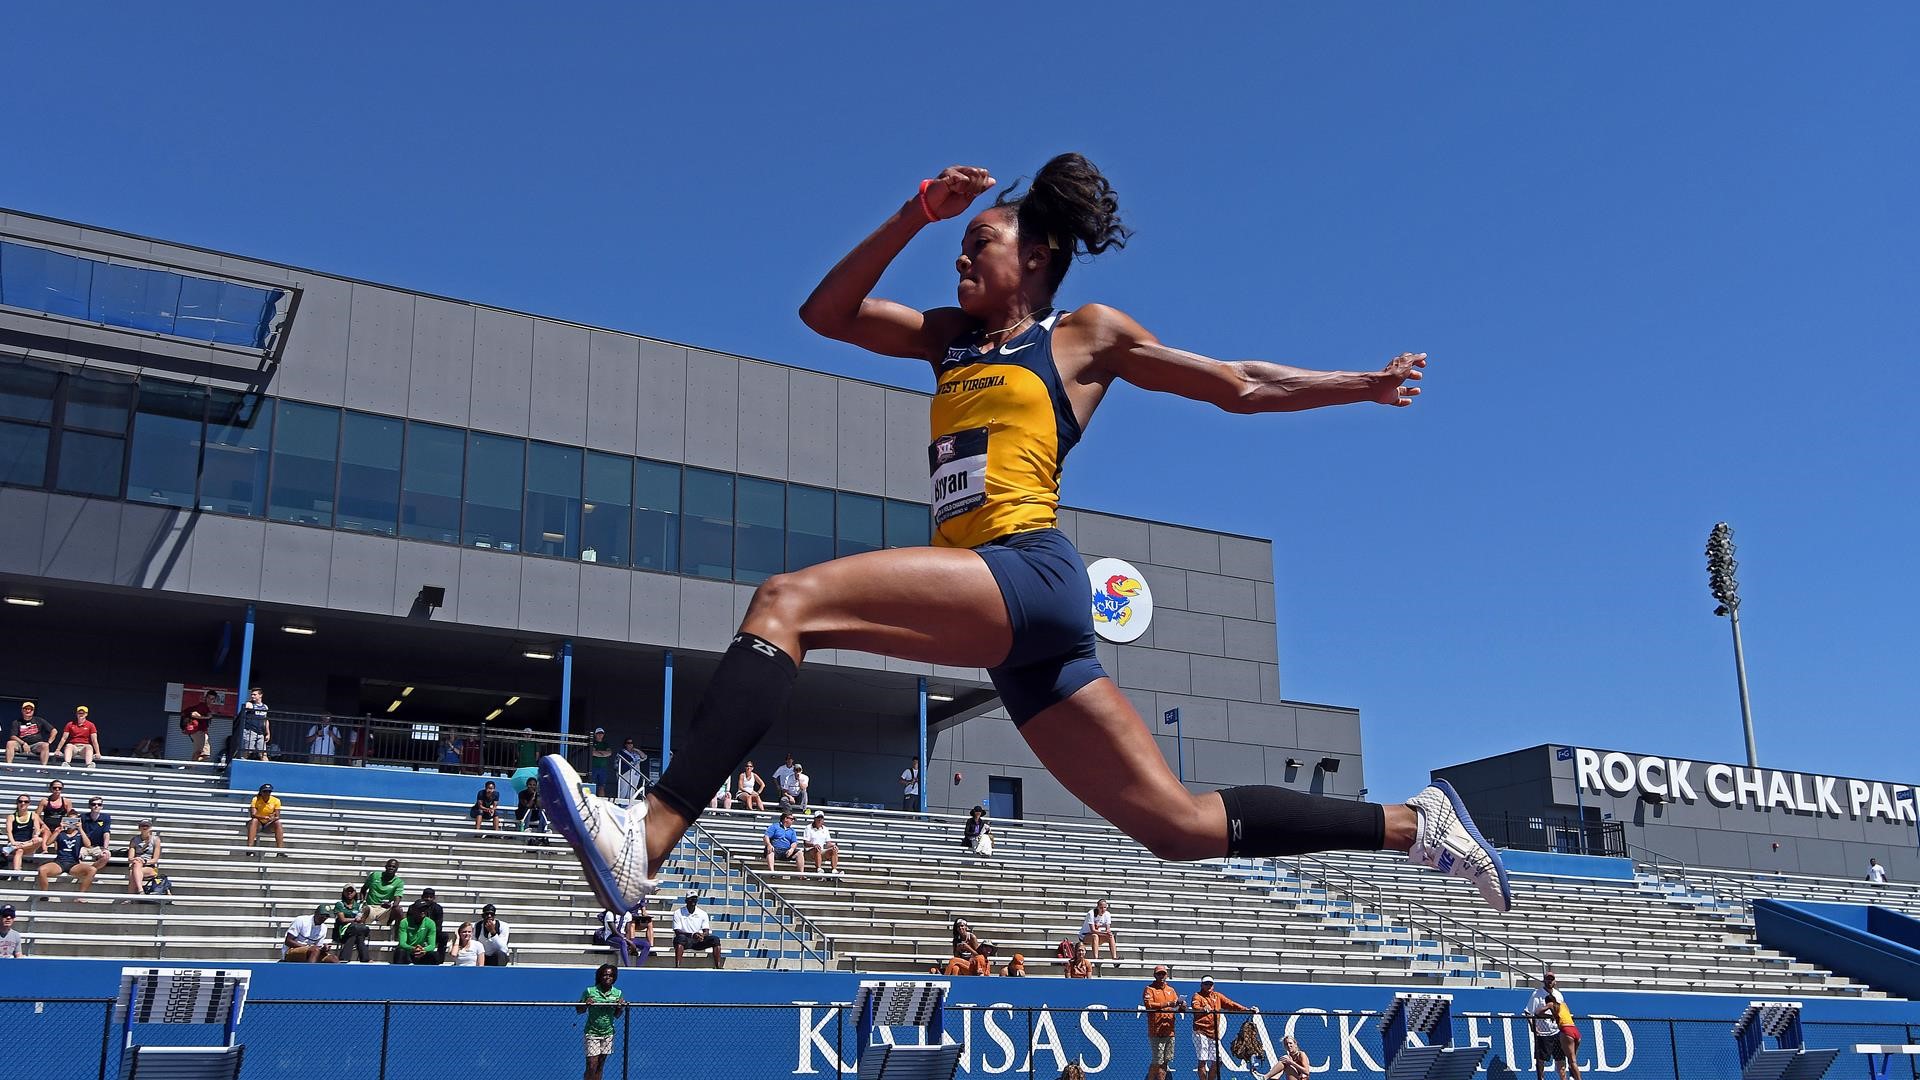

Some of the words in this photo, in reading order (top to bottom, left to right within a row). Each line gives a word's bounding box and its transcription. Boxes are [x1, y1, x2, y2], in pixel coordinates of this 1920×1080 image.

[934, 470, 968, 502] Bryan
[1104, 600, 1119, 612] KU
[1575, 748, 1699, 800] ROCK
[1706, 764, 1843, 815] CHALK
[1849, 779, 1920, 824] PAR
[792, 1001, 1112, 1074] KNSAS
